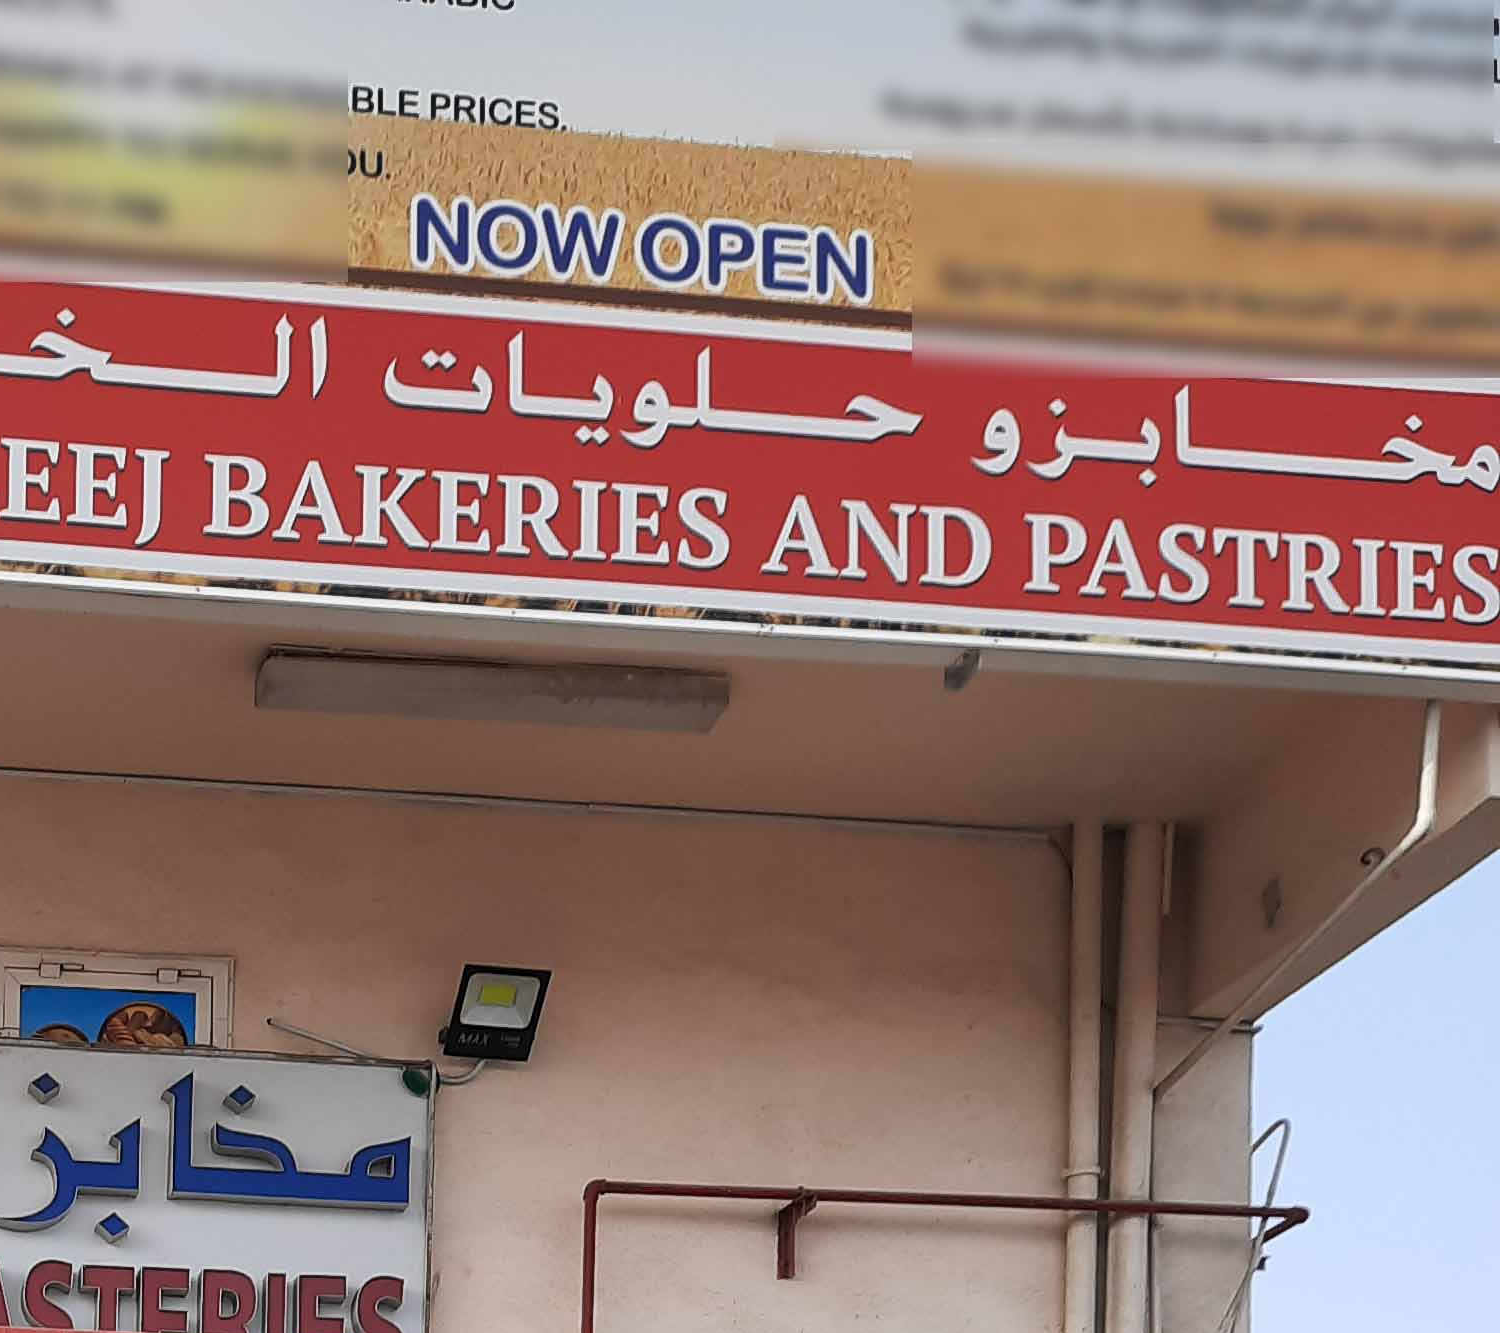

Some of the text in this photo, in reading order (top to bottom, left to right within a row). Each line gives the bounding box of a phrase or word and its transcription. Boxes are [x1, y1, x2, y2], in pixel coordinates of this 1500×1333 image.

[430, 93, 568, 131] PRICES.
[414, 198, 621, 277] NOW
[639, 217, 868, 298] OPEN
[385, 331, 924, 449] حلويات
[203, 453, 730, 570] BAKERIES
[761, 494, 994, 588] AND
[1022, 511, 1500, 625] PASTRIES
